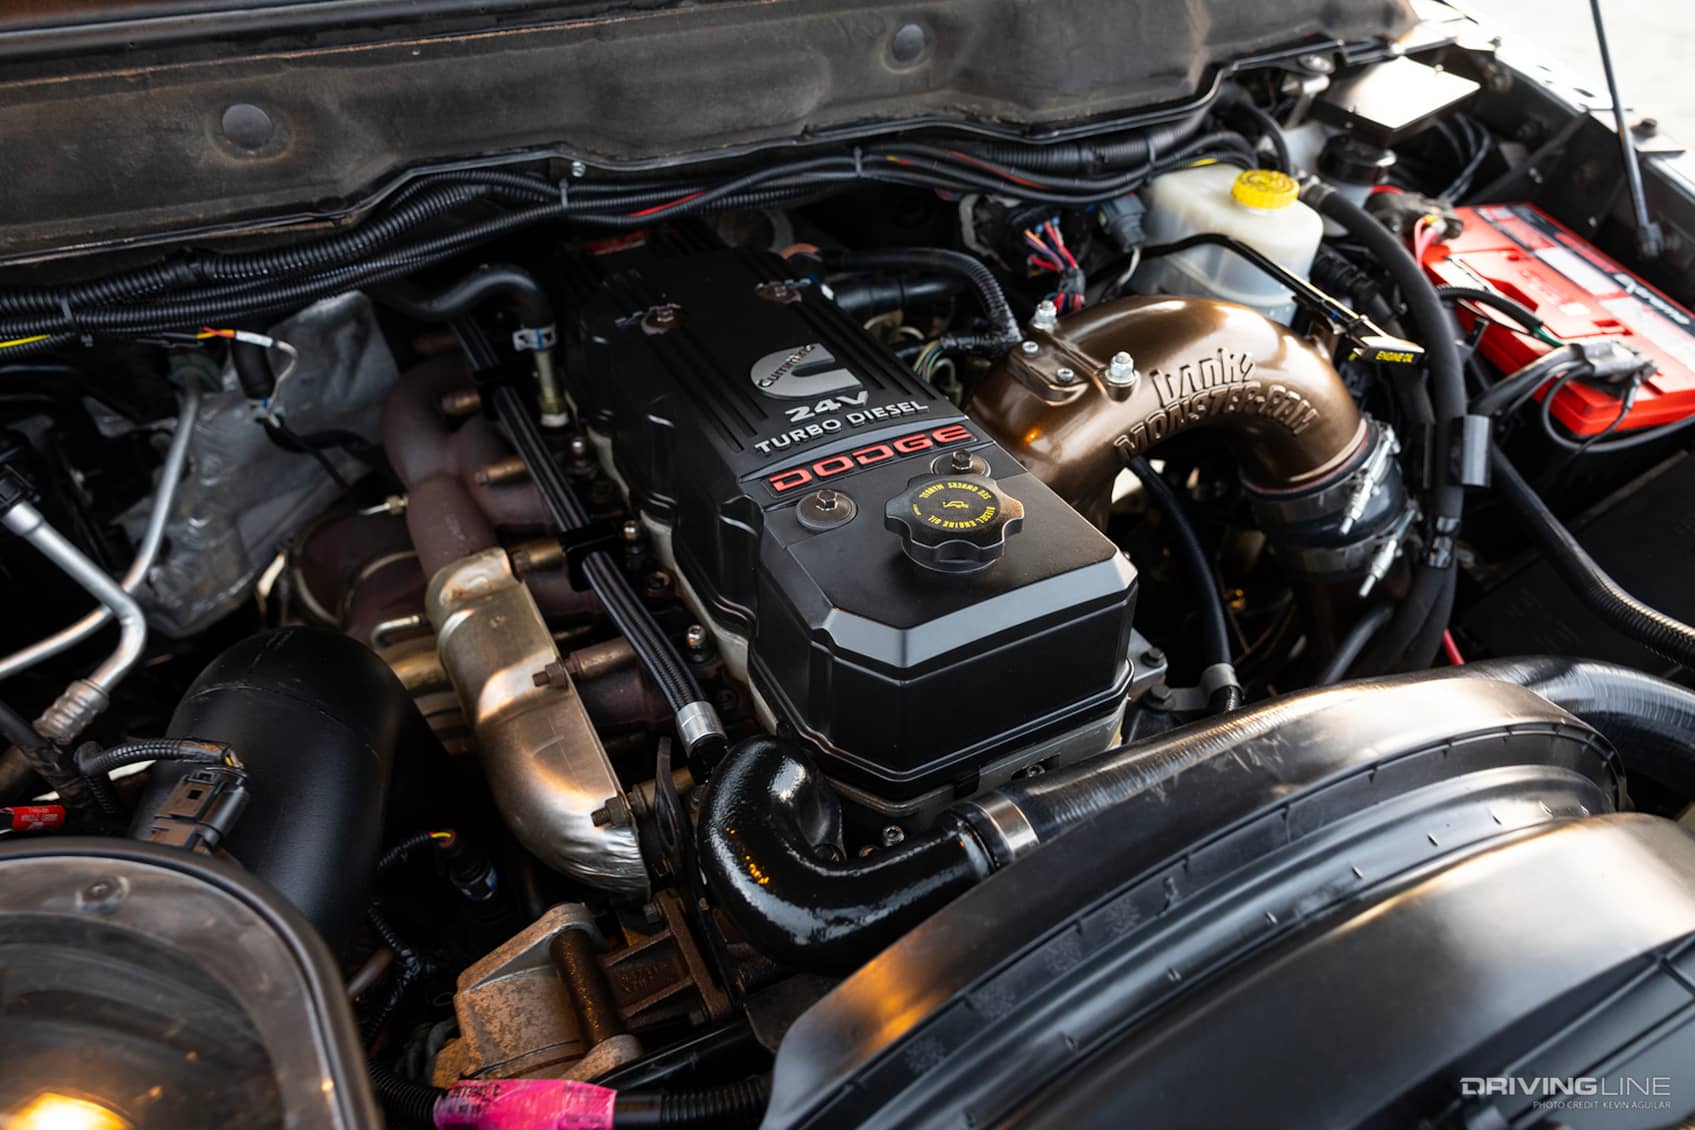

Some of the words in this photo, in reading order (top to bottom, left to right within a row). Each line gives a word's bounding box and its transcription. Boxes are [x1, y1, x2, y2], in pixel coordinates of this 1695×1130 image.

[756, 344, 816, 387] Cummins
[755, 418, 841, 454] TURBO
[846, 400, 929, 426] DIESEL
[785, 390, 869, 422] 24V
[768, 424, 972, 492] DODGE
